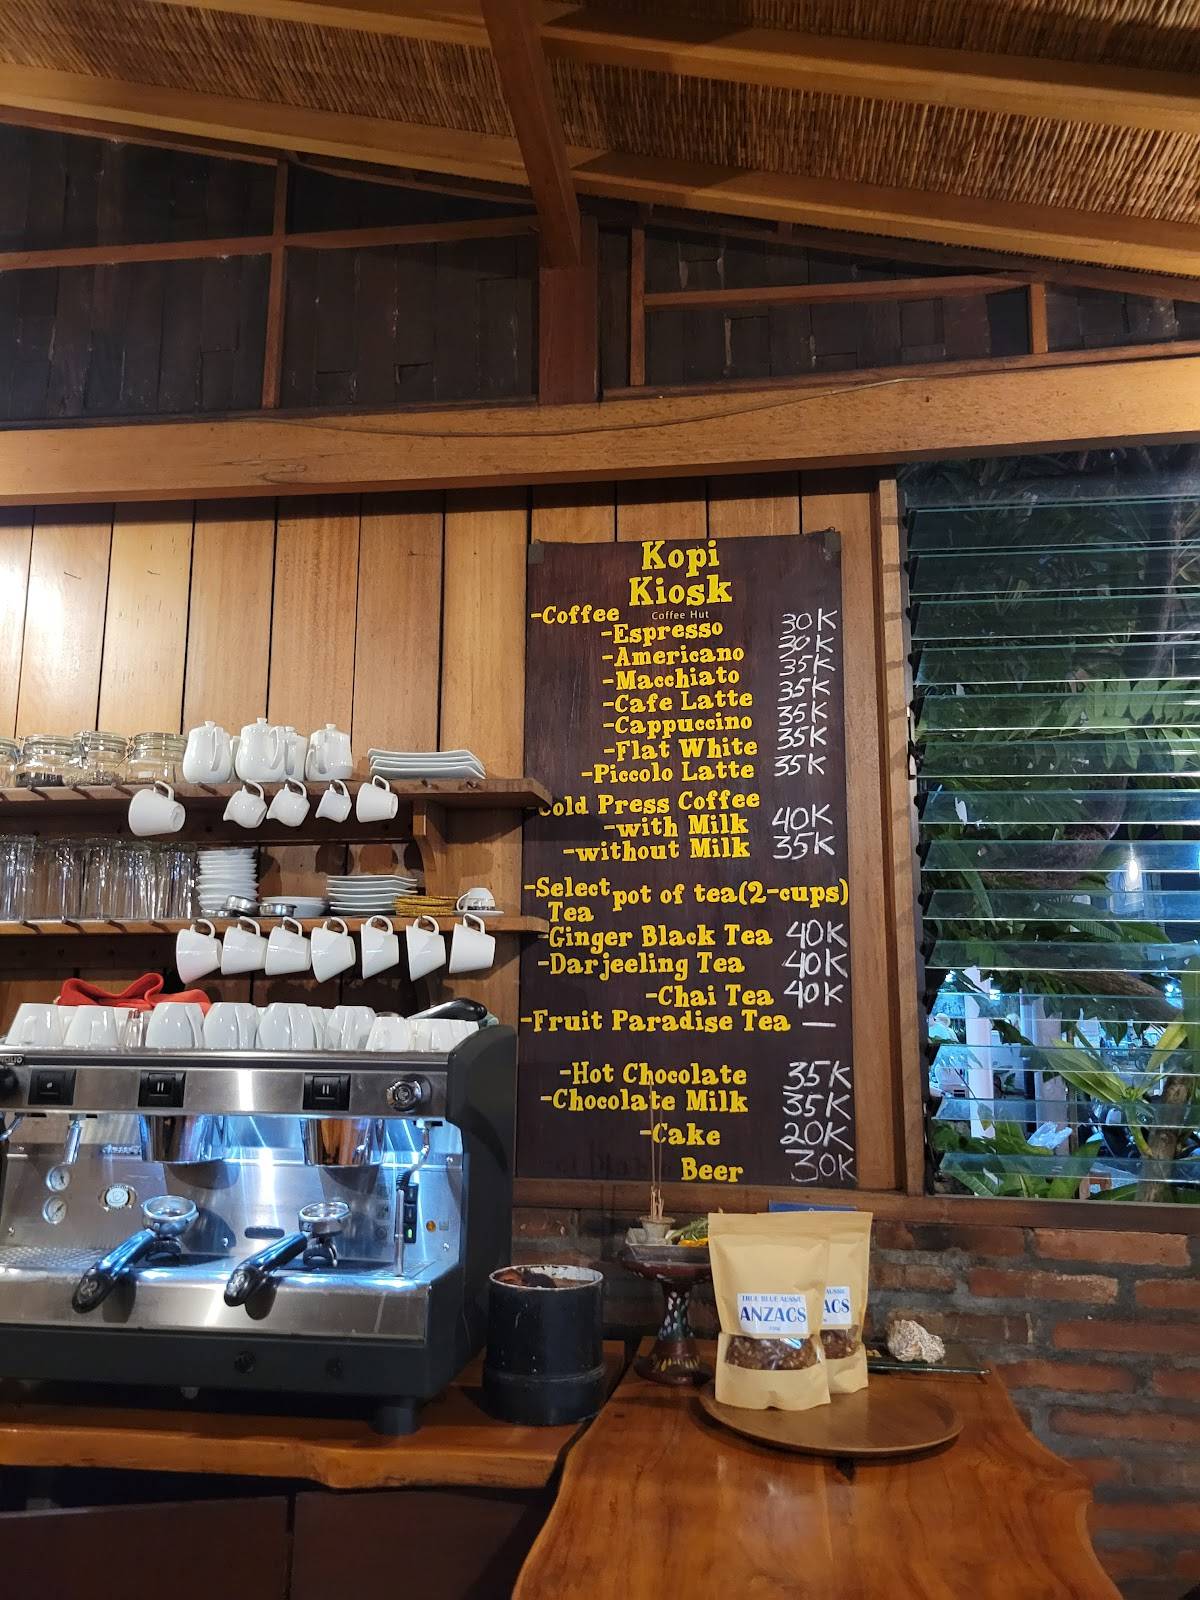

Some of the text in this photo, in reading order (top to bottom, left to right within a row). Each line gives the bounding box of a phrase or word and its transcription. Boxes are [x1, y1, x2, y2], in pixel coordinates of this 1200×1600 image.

[641, 539, 720, 578] Kopi
[628, 574, 733, 607] Kiosk
[531, 605, 620, 625] -Coffee
[651, 609, 710, 620] Coffee Hut
[781, 608, 838, 634] 30K
[601, 621, 724, 647] -Espresso
[602, 645, 745, 668] -Americano
[779, 653, 836, 677] 35K
[603, 666, 740, 691] -Macchiato
[777, 675, 831, 701] 35K
[603, 690, 753, 714] -Cafe Latte
[777, 700, 828, 726] 35K
[603, 712, 753, 740] -Cappuccino
[776, 725, 828, 750] 35K
[603, 737, 758, 762] -Flat White
[581, 761, 755, 784] -Piccolo Latte
[774, 752, 827, 777] 35K
[598, 794, 670, 815] Press
[678, 790, 760, 811] Coffee
[604, 813, 750, 839] -with Milk
[772, 803, 833, 834] 40K
[563, 837, 751, 862] -without Milk
[772, 831, 836, 861] 35K
[524, 876, 611, 898] -Select
[612, 885, 652, 912] pot
[660, 884, 686, 905] of
[547, 901, 595, 923] Tea
[641, 925, 716, 947] Black
[724, 924, 774, 946] Tea
[785, 919, 848, 950] 40K
[697, 951, 746, 974] Tea
[781, 948, 848, 979] 40K
[646, 984, 775, 1008] -Chai Tea
[783, 979, 844, 1009] 40K
[520, 1009, 792, 1033] -Fruit Paradise Tea
[559, 1061, 747, 1087] -Hot Chocolate
[783, 1060, 852, 1091] 35K
[540, 1088, 749, 1113] -Chocolate Milk
[782, 1091, 852, 1120] 35K
[640, 1122, 721, 1146] -Cake
[780, 1120, 854, 1151] 20K
[680, 1156, 744, 1183] Beer
[784, 1149, 857, 1182] 30K
[740, 1306, 807, 1323] ANZACS
